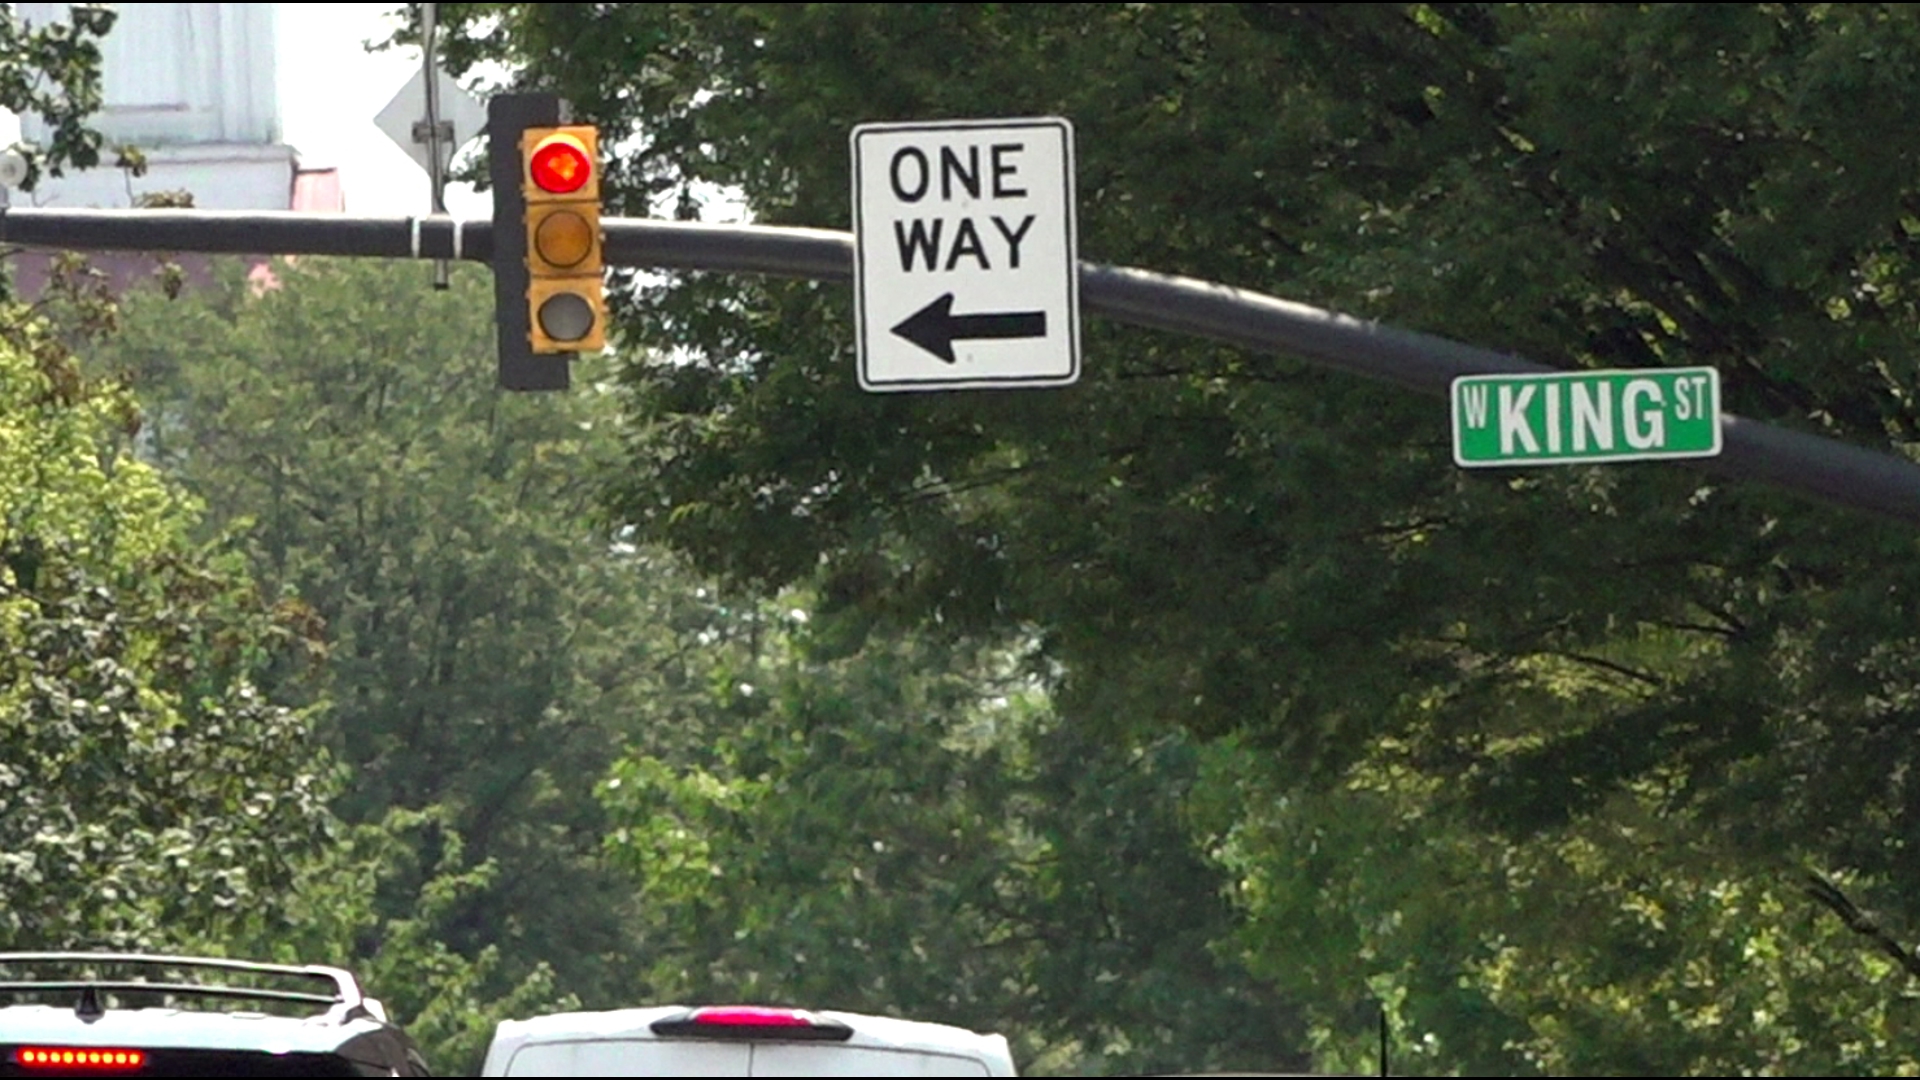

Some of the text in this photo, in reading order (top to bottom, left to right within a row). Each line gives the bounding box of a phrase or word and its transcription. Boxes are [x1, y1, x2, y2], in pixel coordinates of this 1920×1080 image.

[889, 143, 1028, 203] ONE
[894, 215, 1036, 272] WAY
[1463, 376, 1707, 455] W KING ST
